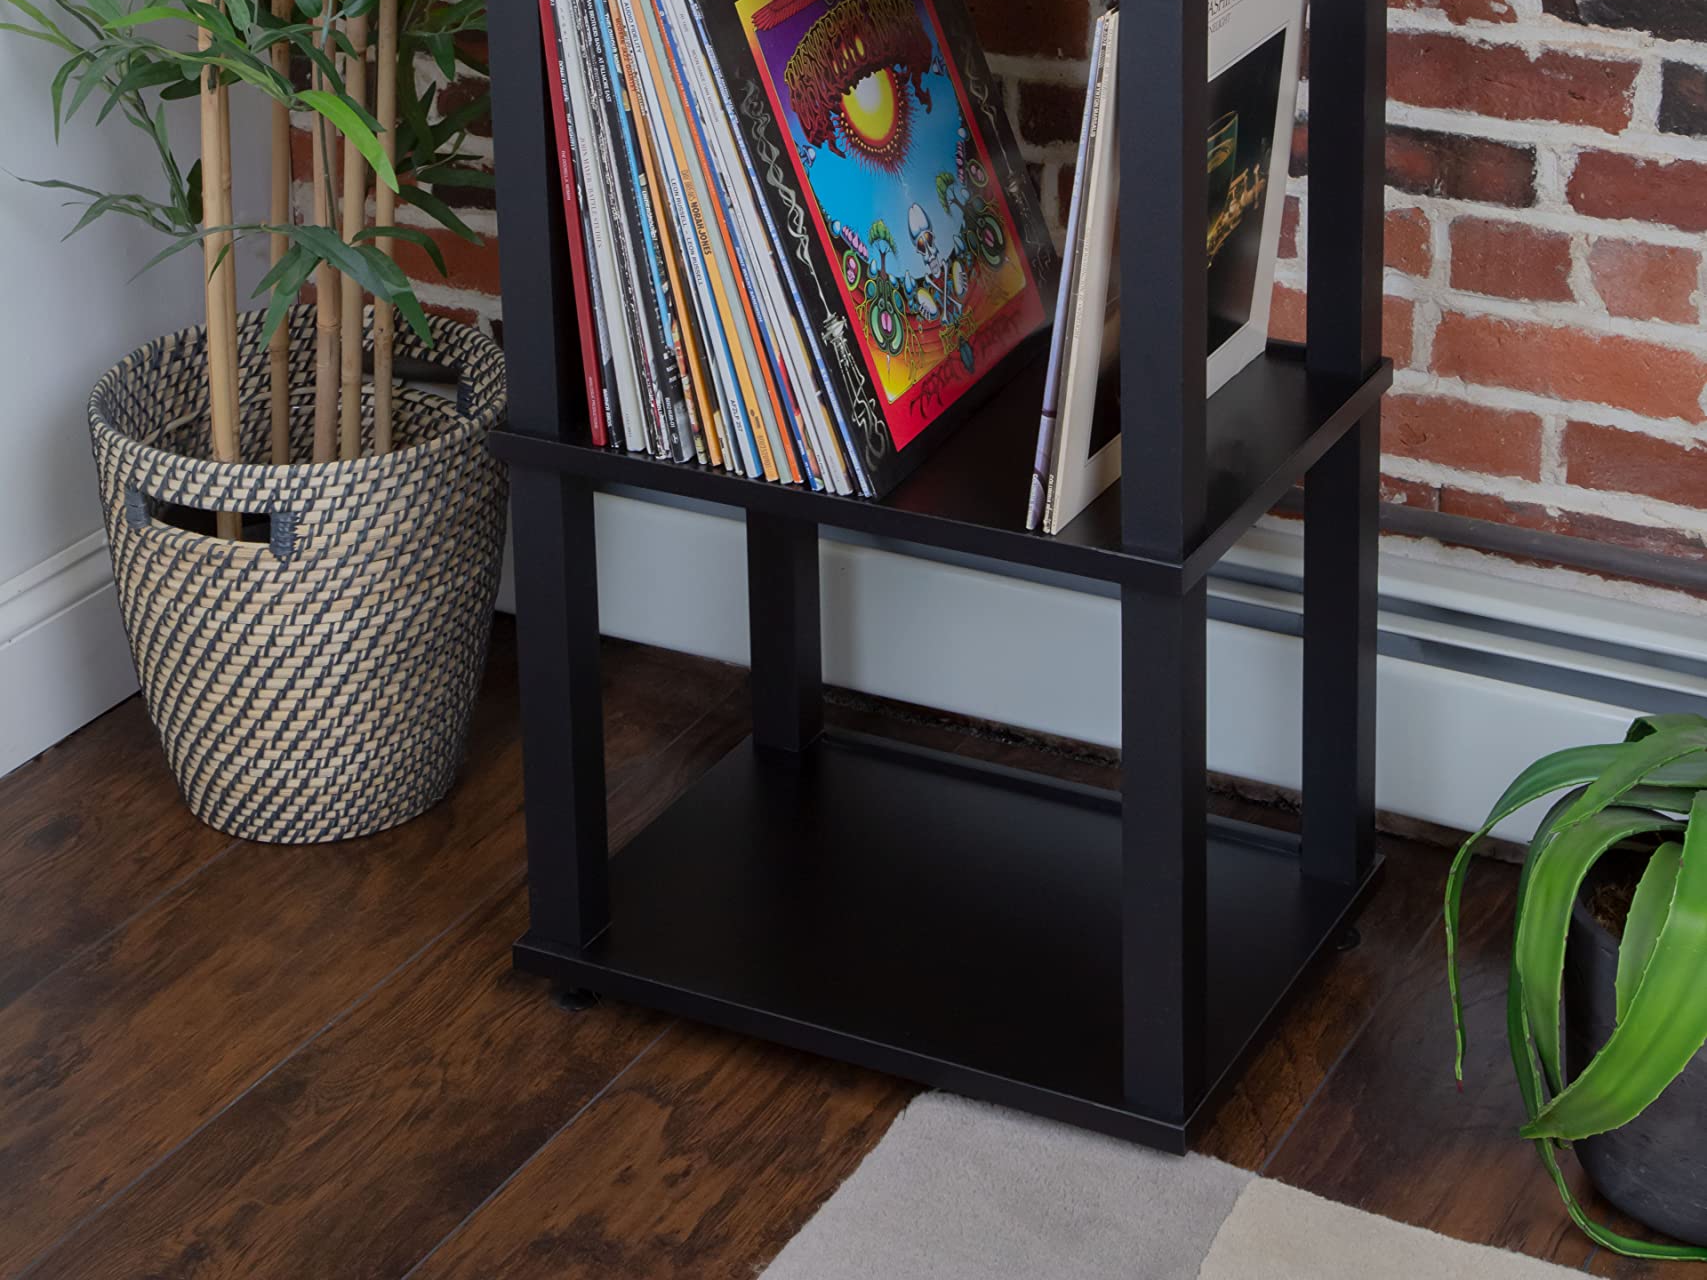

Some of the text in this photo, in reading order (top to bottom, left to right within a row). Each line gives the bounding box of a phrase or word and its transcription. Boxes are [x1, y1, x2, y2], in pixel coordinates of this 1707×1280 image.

[588, 10, 597, 36] BROTHERS
[624, 1, 633, 23] AUDIO
[630, 24, 641, 54] FIDELITY
[598, 56, 603, 64] AT
[600, 64, 608, 89] FILLMORE
[614, 16, 625, 45] MODERN
[626, 63, 636, 92] QUARTET
[671, 177, 679, 196] LEON
[676, 196, 687, 227] RUSSELL
[686, 236, 694, 256] LEON
[692, 255, 702, 286] RUSSELL
[691, 200, 704, 230] NORAH
[698, 228, 711, 256] JONES
